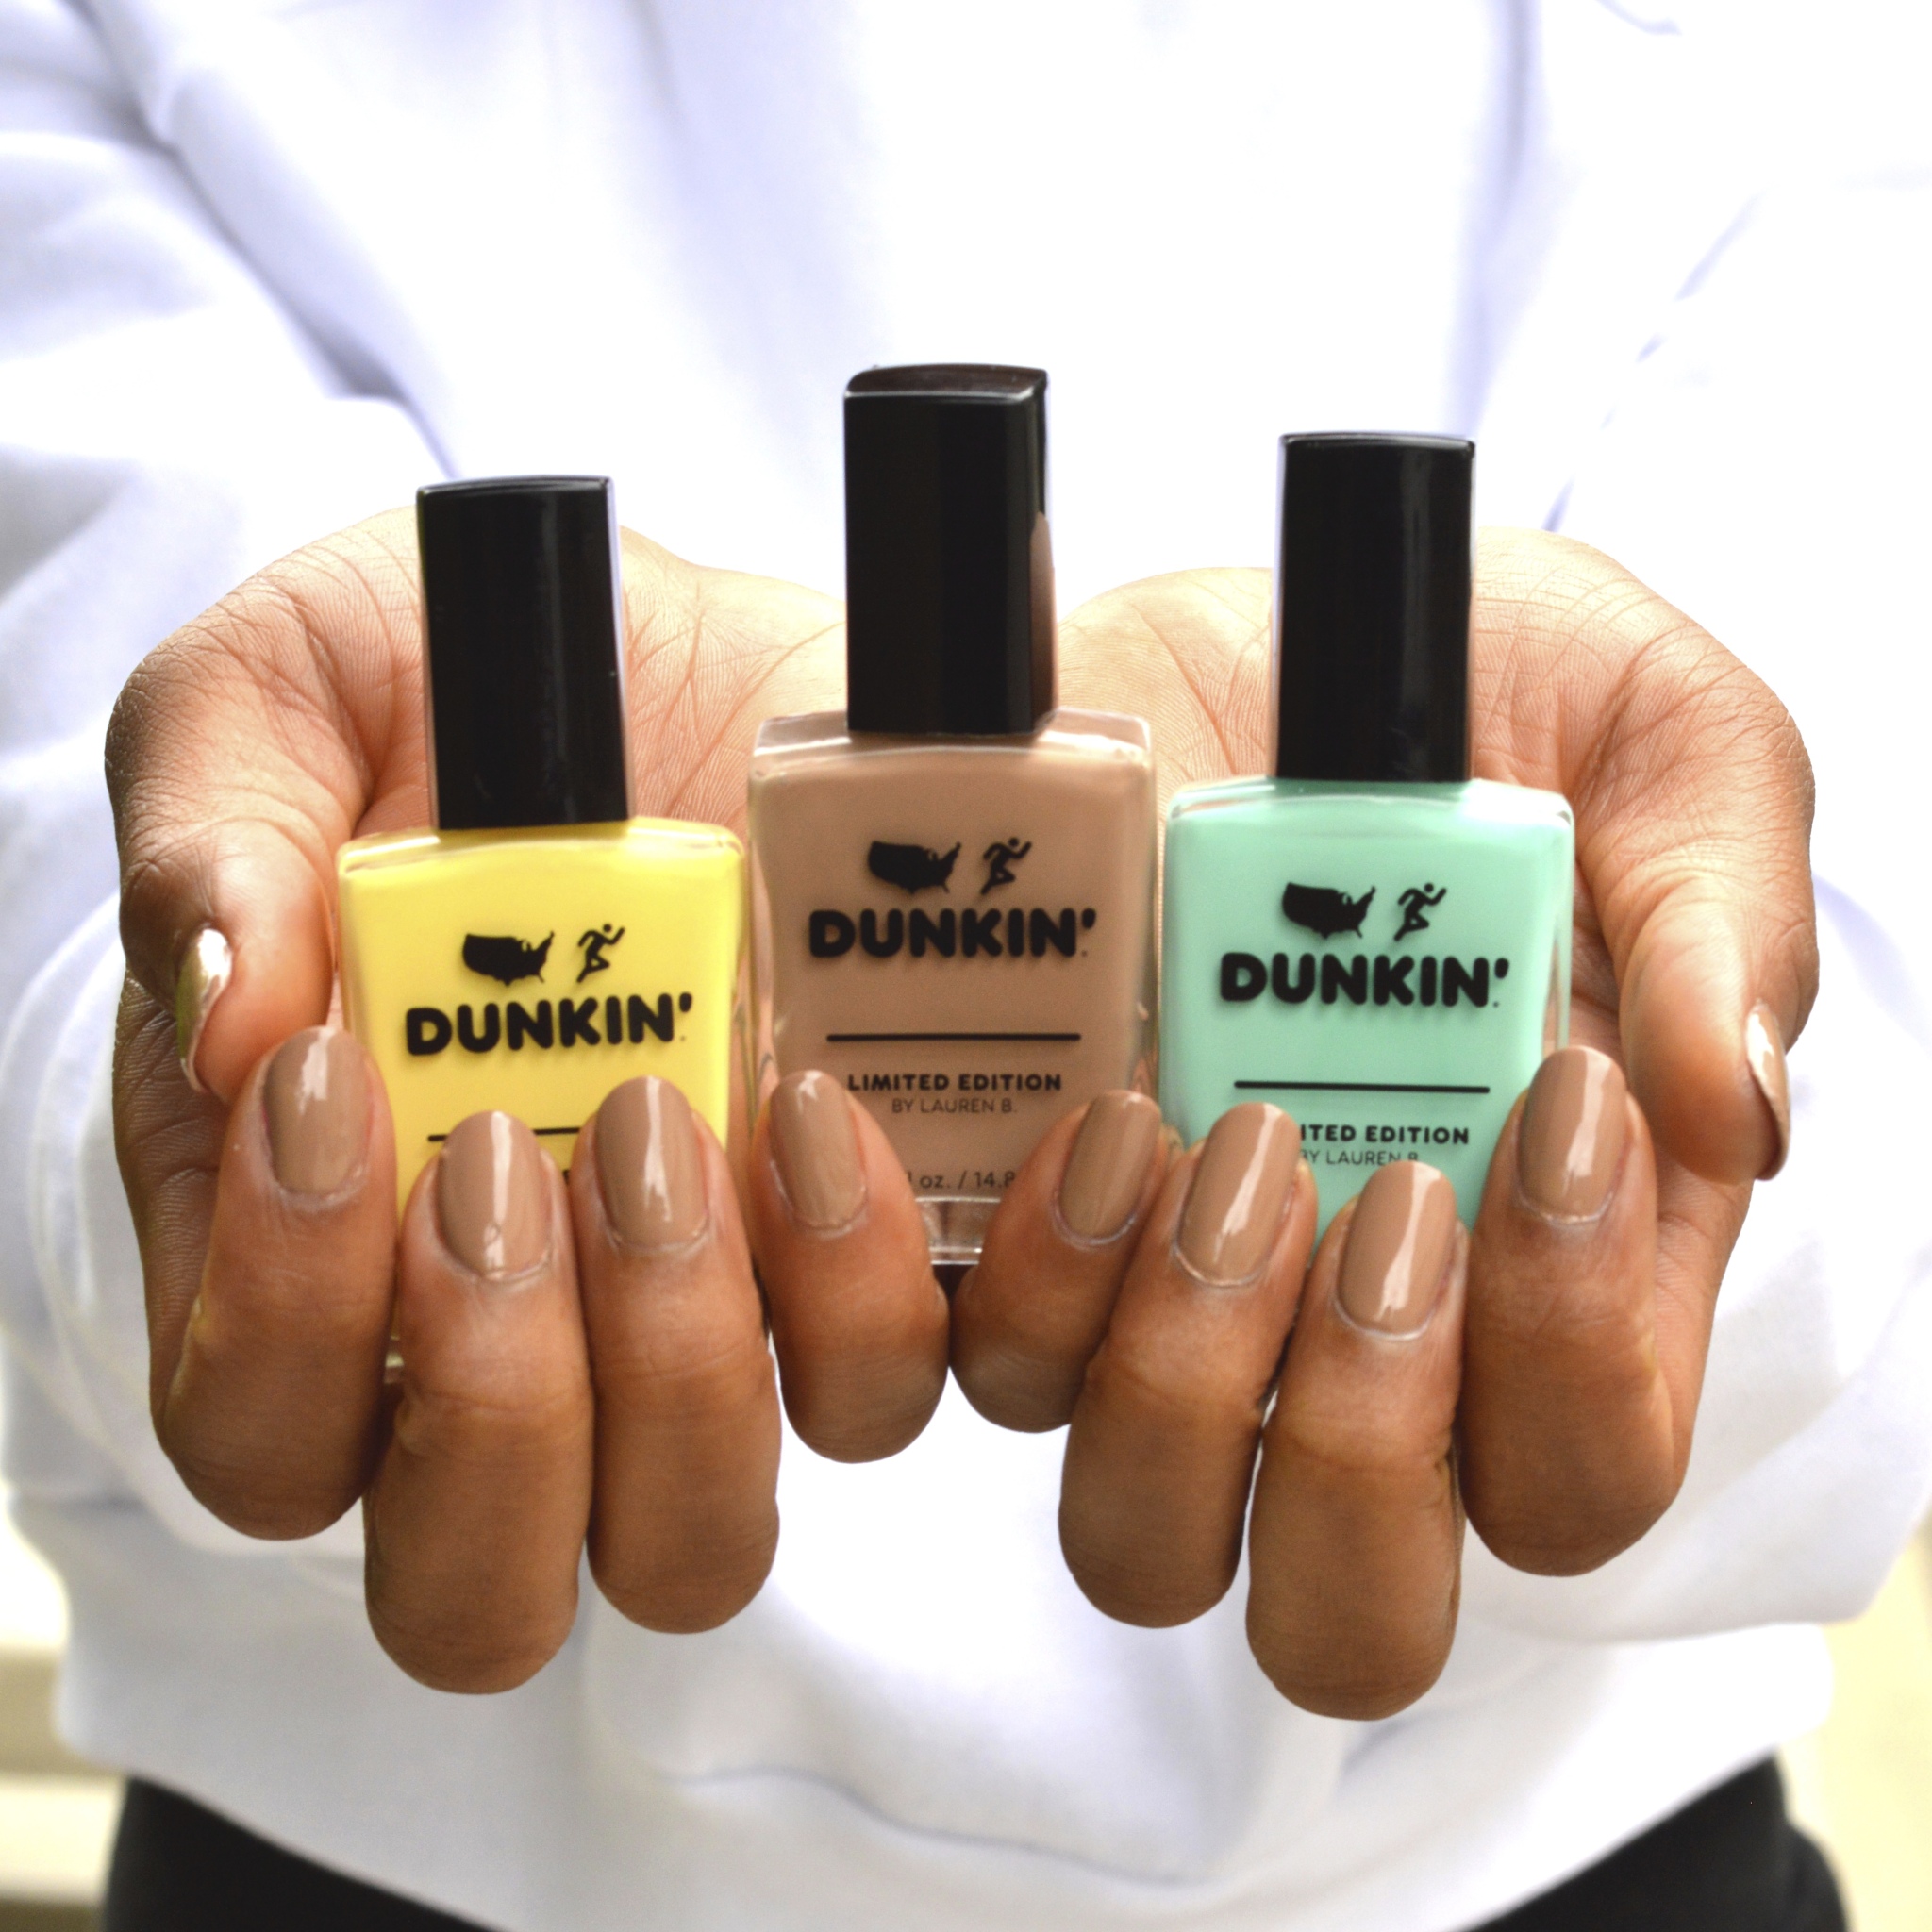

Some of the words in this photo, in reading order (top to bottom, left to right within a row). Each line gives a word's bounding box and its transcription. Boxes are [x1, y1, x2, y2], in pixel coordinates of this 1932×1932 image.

[808, 908, 1096, 958] DUNKIN'
[1220, 952, 1508, 1008] DUNKIN'
[406, 991, 692, 1056] DUNKIN'
[847, 1074, 950, 1091] LIMITED
[958, 1074, 1062, 1091] EDITION
[891, 1097, 914, 1114] BY
[920, 1098, 995, 1114] LAUREN
[1001, 1098, 1018, 1114] B.
[1300, 1124, 1357, 1142] ITED
[1365, 1125, 1470, 1145] EDITION
[1325, 1150, 1402, 1166] LAUREN
[919, 1175, 950, 1189] oz.
